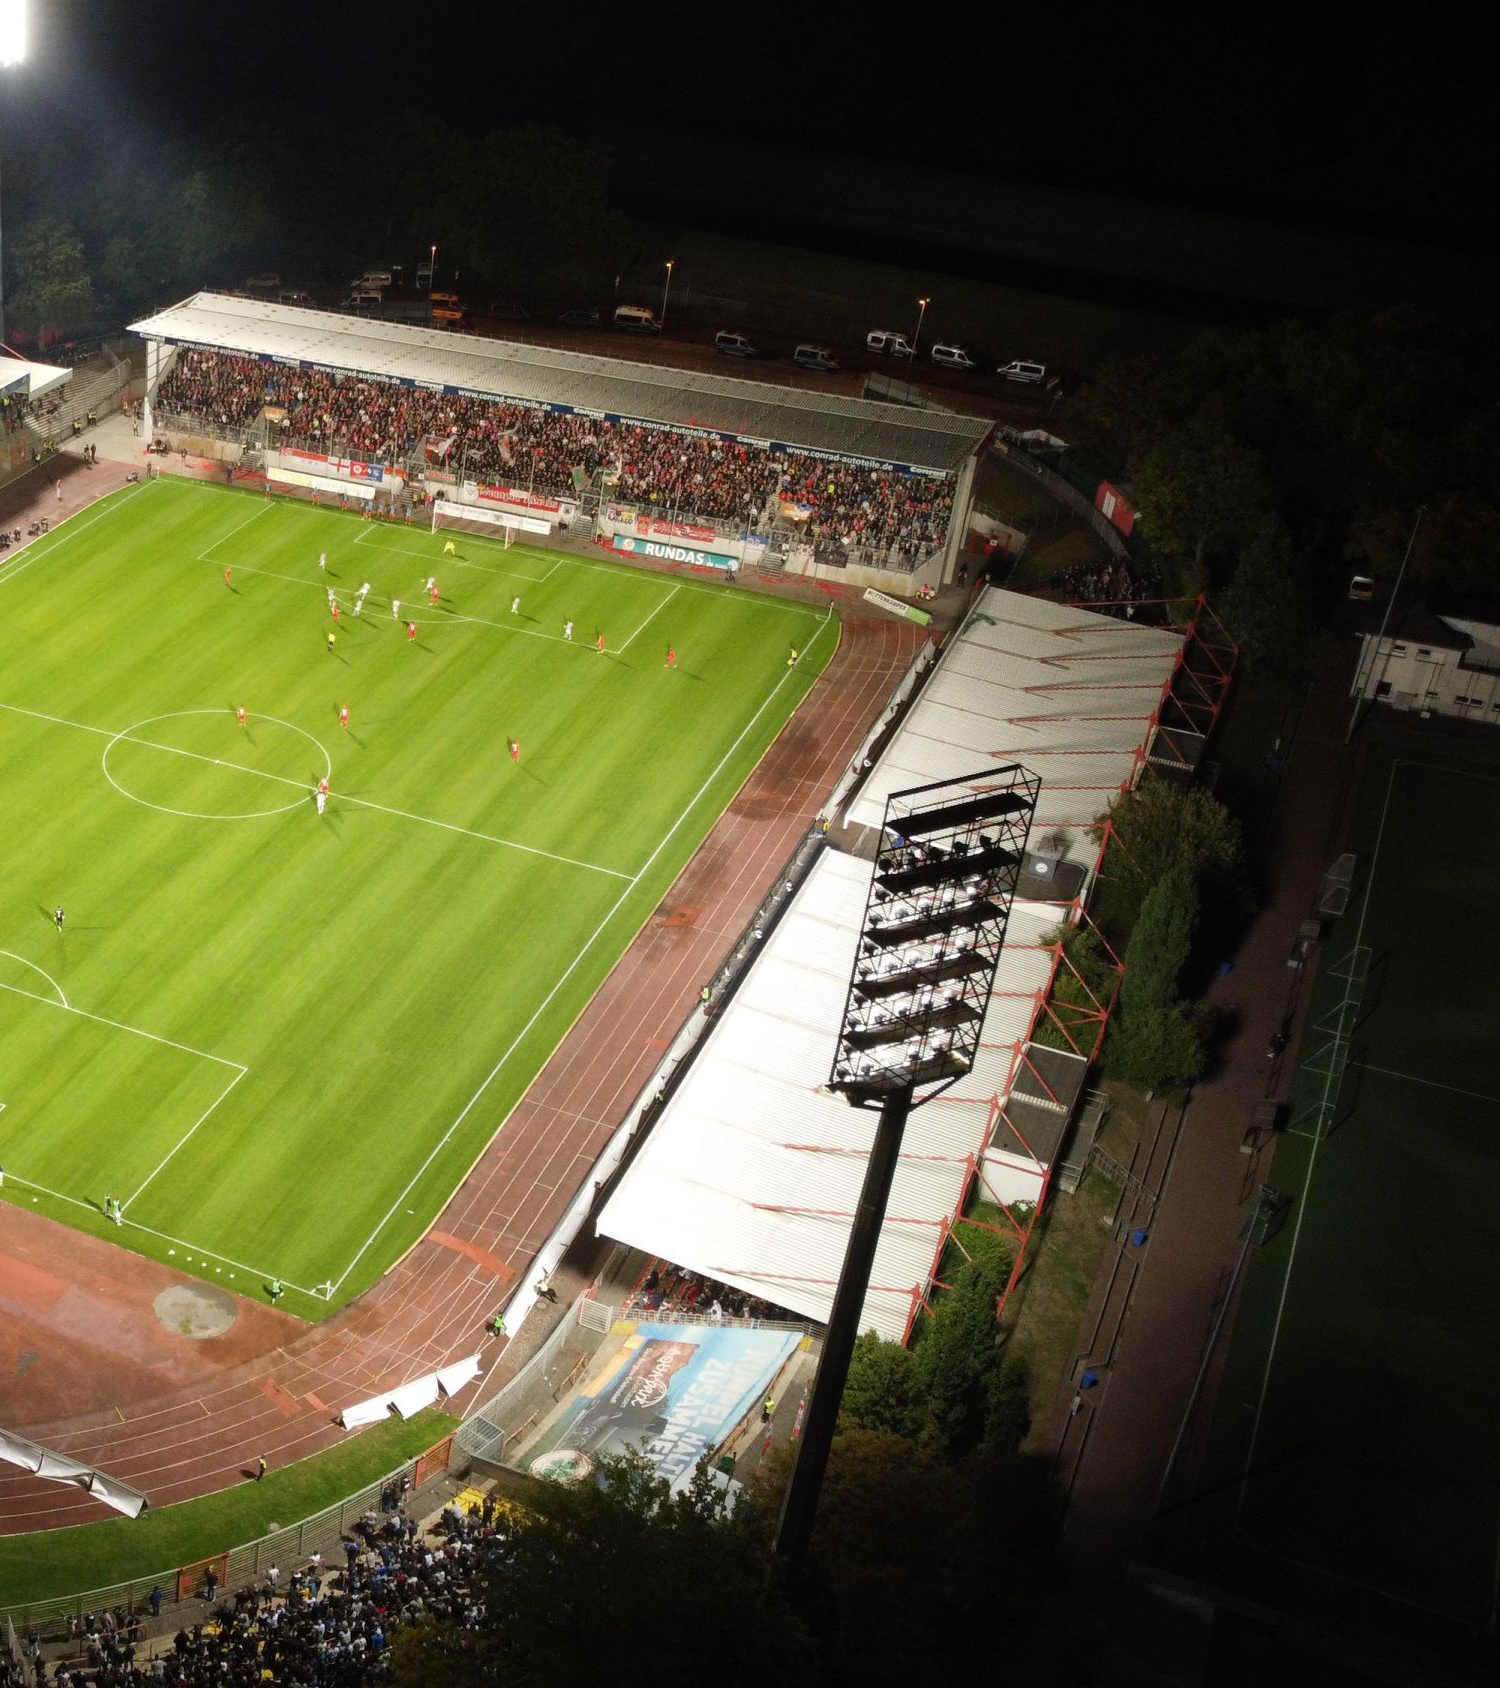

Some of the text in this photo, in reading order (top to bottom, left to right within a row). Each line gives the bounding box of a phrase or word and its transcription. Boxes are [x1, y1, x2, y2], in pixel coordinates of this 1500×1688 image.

[177, 340, 260, 360] www.conrad-autoteile.de
[312, 362, 401, 384] www.conrad-autoteile.de
[414, 379, 444, 390] Conrad
[457, 388, 552, 411] www.conrad-autoteile.de
[573, 406, 605, 418] Conrad
[619, 416, 721, 441] www.conrad-autoteile.de
[736, 435, 771, 447] Conrad
[786, 446, 894, 471] www.conrad-autoteile.de
[909, 465, 946, 478] Conrad
[644, 541, 705, 566] RUNDAS
